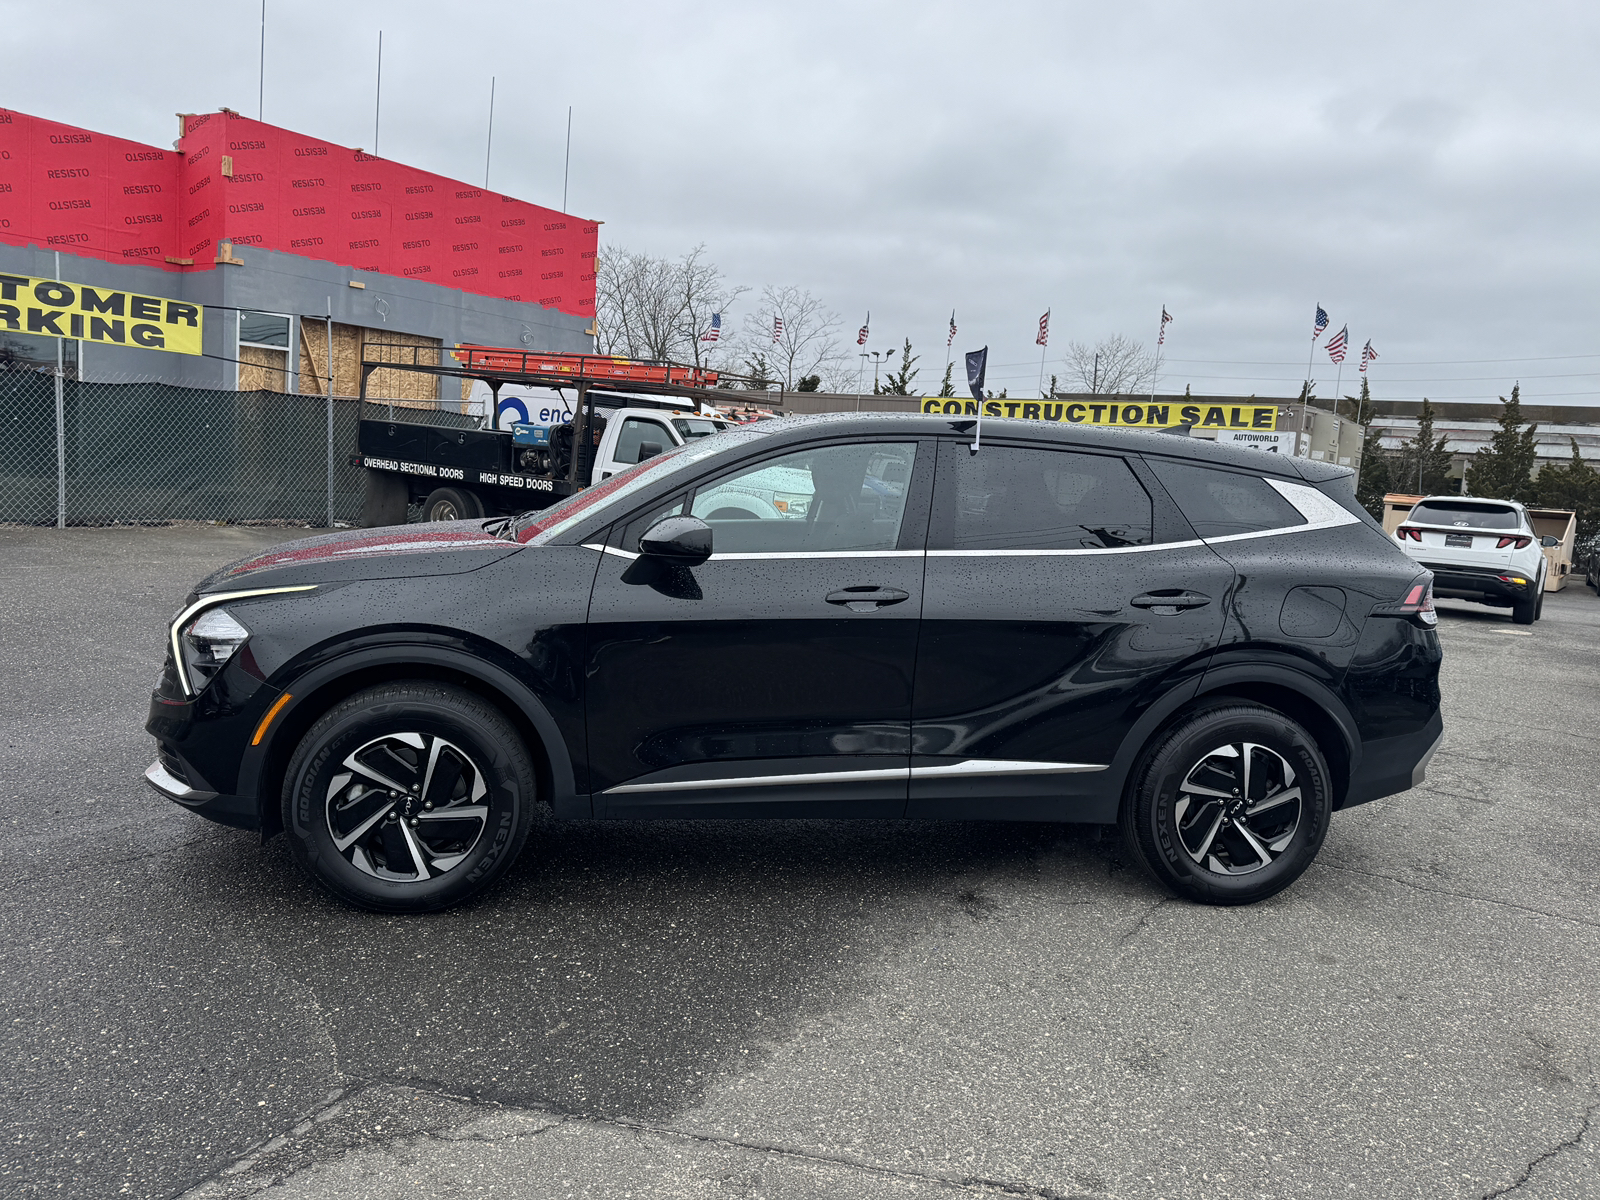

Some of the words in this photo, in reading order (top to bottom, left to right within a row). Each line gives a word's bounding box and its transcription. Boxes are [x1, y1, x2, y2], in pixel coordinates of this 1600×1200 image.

[188, 146, 210, 166] RESISTO
[48, 169, 89, 179] RESISTO
[228, 173, 263, 183] RESISTO
[292, 178, 325, 188] RESISTO
[351, 183, 381, 192] RESISTO
[123, 185, 162, 195] RESISTO
[405, 185, 433, 194] RESISTO
[455, 190, 481, 199] RESISTO
[188, 208, 210, 227] RESISTO
[47, 233, 89, 245] RESISTO
[290, 237, 323, 248] RESISTO
[349, 239, 379, 250] RESISTO
[402, 239, 431, 250] RESISTO
[122, 246, 160, 258] RESISTO
[452, 242, 478, 252] RESISTO
[498, 245, 523, 254] RESISTO
[541, 248, 564, 257] RESISTO
[0, 275, 199, 327] TOMER
[539, 296, 562, 305] RESISTO
[924, 400, 1170, 424] CONSTRUCTION
[1180, 406, 1274, 428] SALE
[1233, 433, 1279, 443] AUTOWORLD
[364, 457, 398, 471] OVERHEAD
[400, 462, 437, 476] SECTIONAL
[439, 468, 464, 480] DOORS
[479, 472, 497, 484] HIGH
[500, 475, 524, 488] SPEED
[526, 479, 553, 491] DOORS
[300, 746, 332, 822] ROADIAN
[1298, 749, 1324, 811] ROADIAN
[1158, 793, 1178, 863] NEXEN
[465, 811, 512, 883] NEXEN
